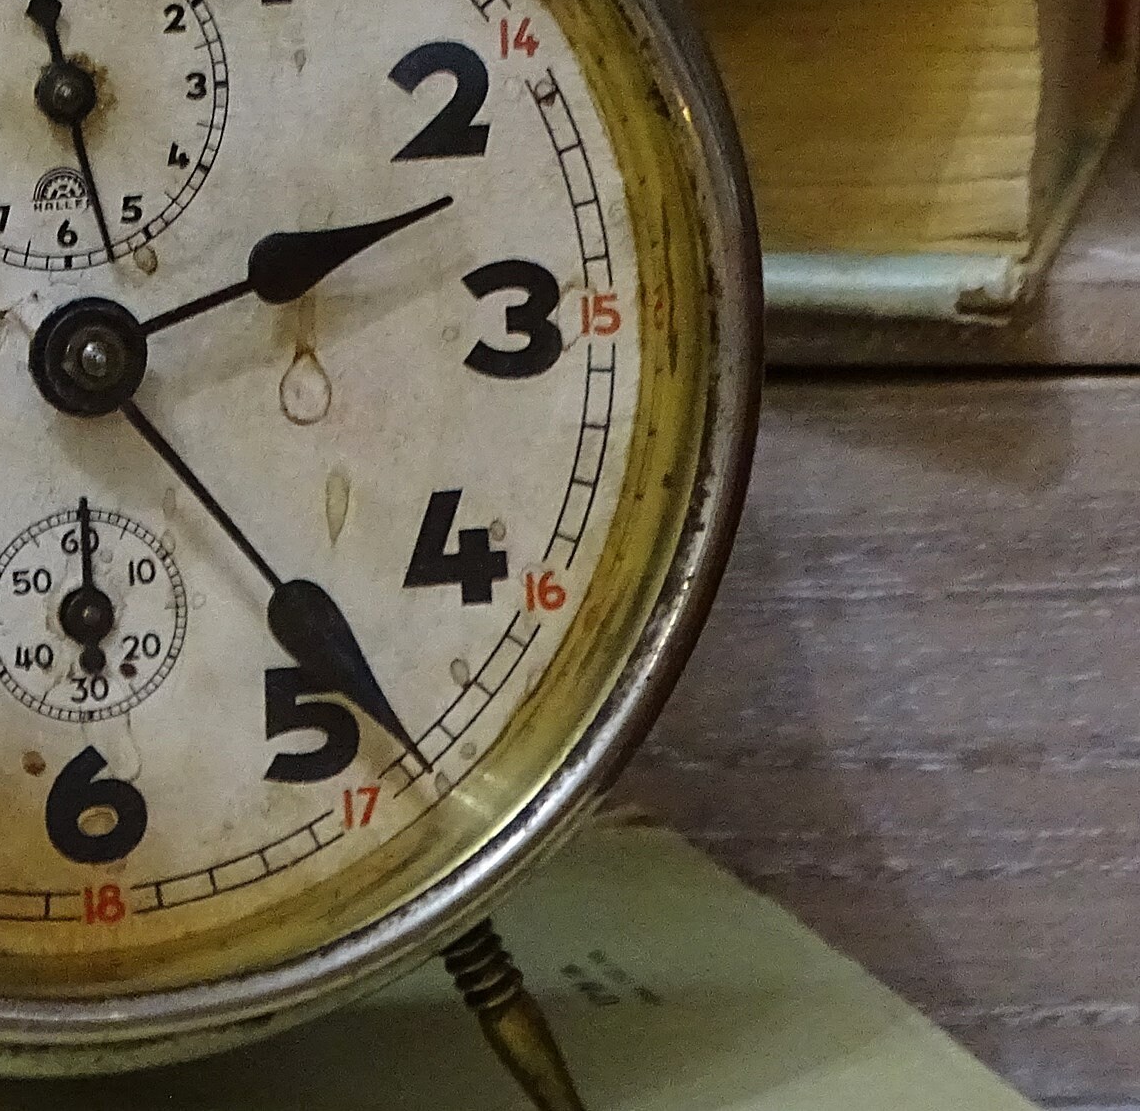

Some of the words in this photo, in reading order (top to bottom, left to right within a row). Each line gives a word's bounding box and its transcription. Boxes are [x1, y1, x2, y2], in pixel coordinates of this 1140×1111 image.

[163, 4, 186, 33] 2
[500, 17, 539, 59] 14
[185, 73, 207, 100] 3
[388, 41, 490, 162] 2
[168, 142, 190, 169] 4
[121, 195, 143, 225] 5
[57, 219, 78, 247] 6
[464, 259, 562, 379] 3
[581, 294, 621, 336] 15
[402, 488, 509, 606] 4
[12, 568, 52, 596] 50
[128, 558, 156, 587] 10
[525, 571, 567, 611] 16
[15, 643, 54, 670] 40
[122, 633, 161, 662] 20
[71, 674, 109, 703] 30
[264, 665, 360, 783] 5
[45, 745, 148, 865] 6
[342, 786, 381, 828] 17
[82, 884, 126, 925] 18
